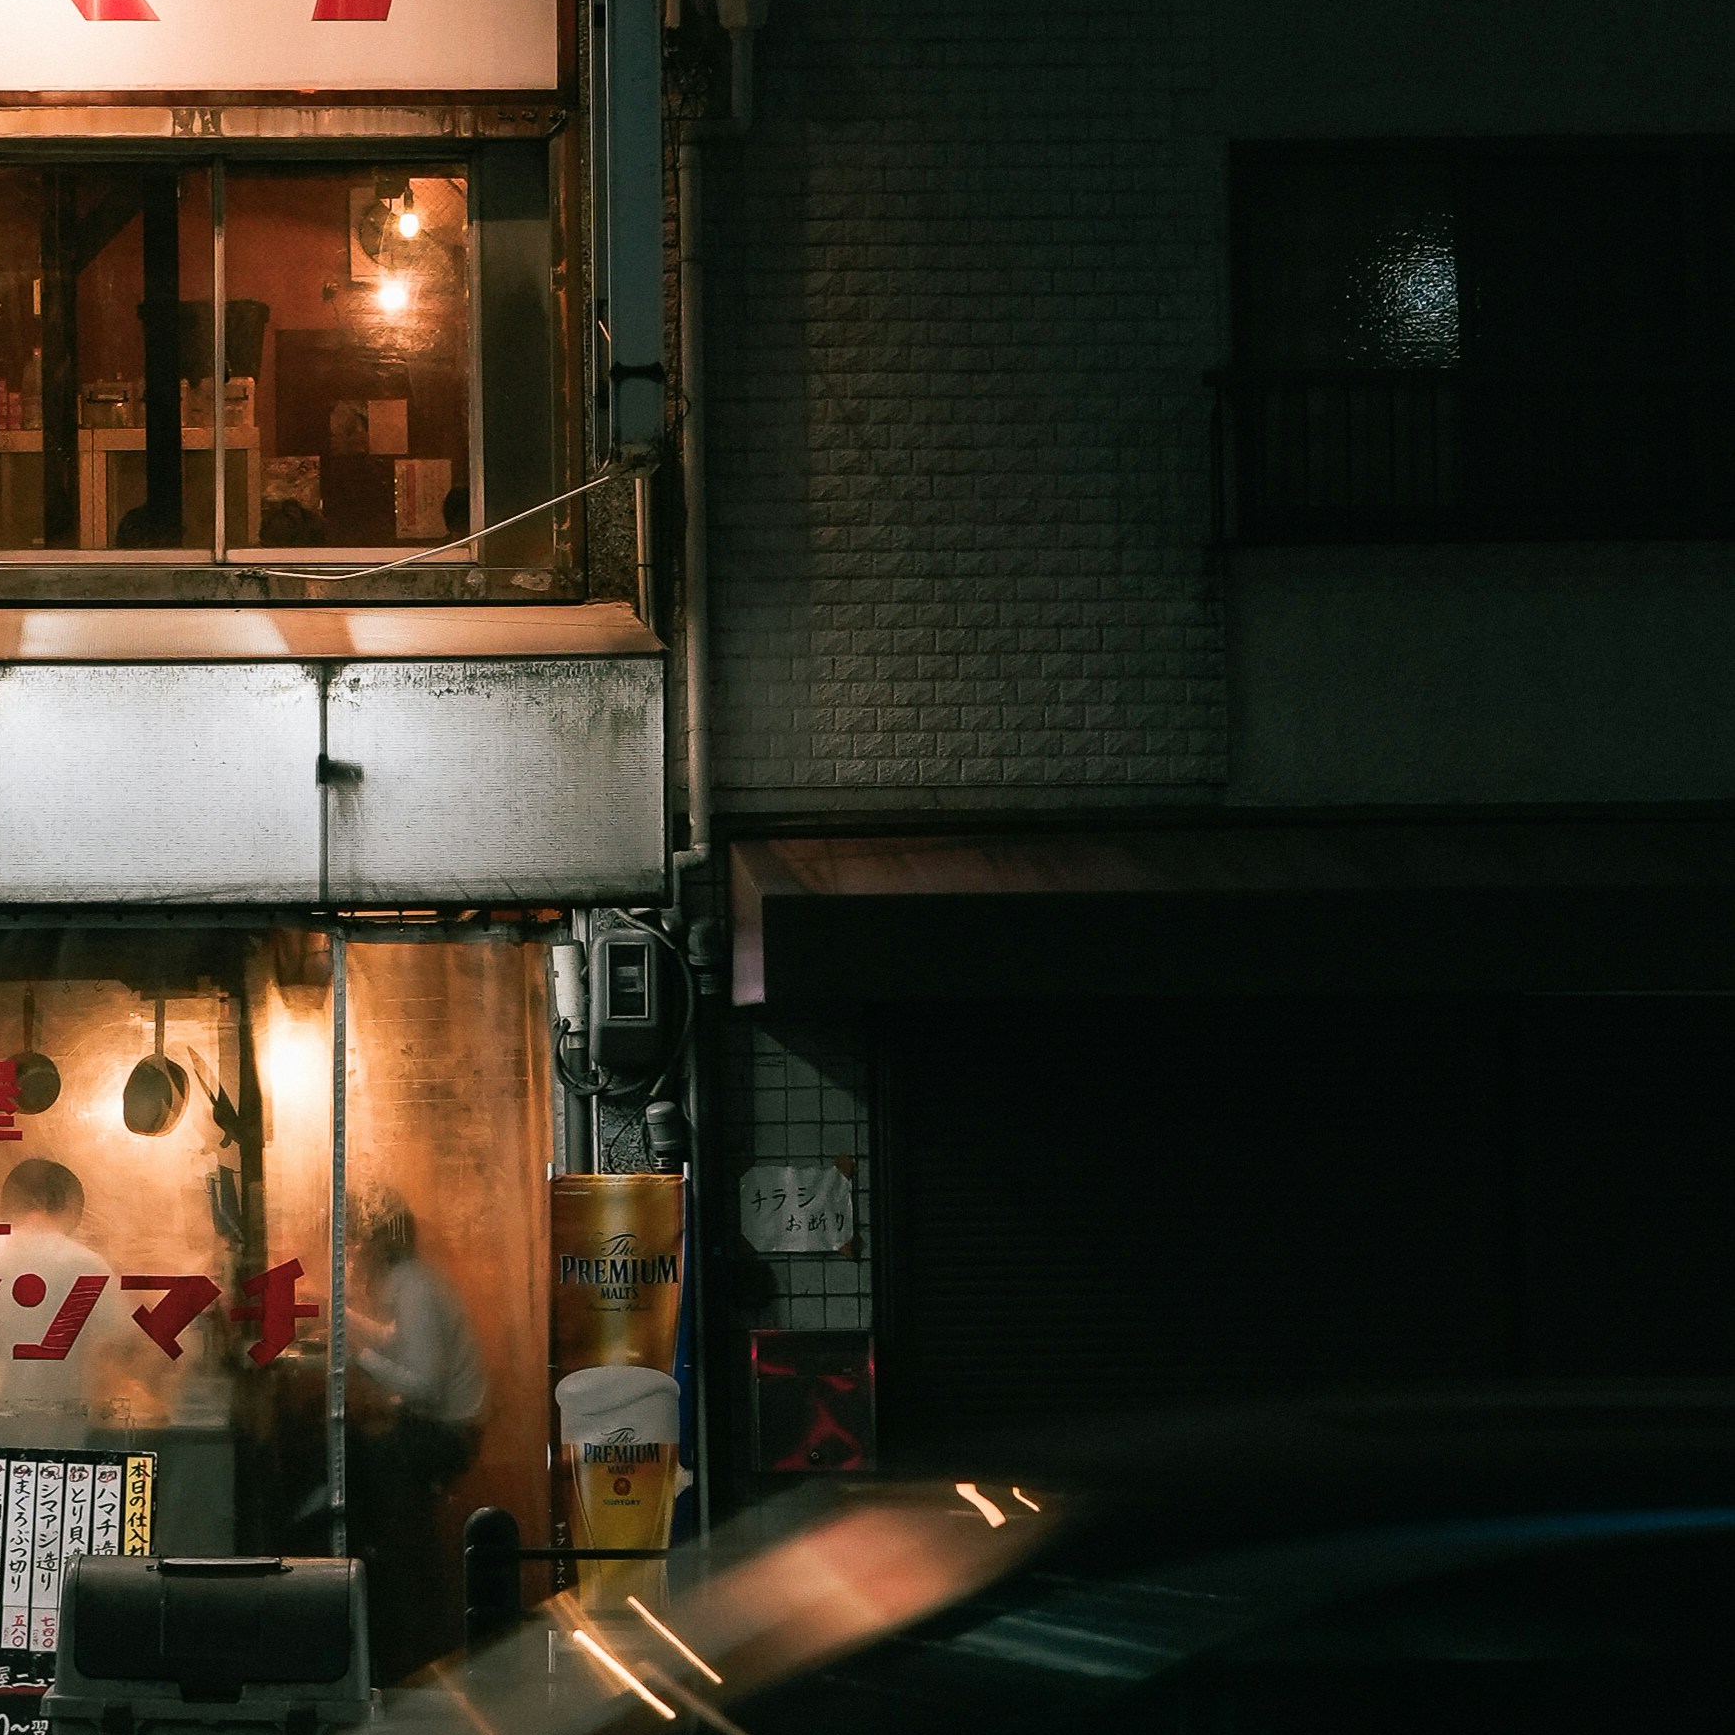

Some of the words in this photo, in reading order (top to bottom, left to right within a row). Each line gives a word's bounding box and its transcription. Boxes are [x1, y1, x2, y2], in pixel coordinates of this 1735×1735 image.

[751, 1187, 816, 1214] チラシ
[785, 1212, 845, 1232] お断り
[594, 1232, 639, 1257] The
[559, 1254, 680, 1284] PREMIUM
[601, 1427, 640, 1444] The
[583, 1442, 661, 1464] PREMIUM
[9, 1479, 31, 1593] まぐろぶつ切り
[36, 1484, 60, 1593] シマアジ造り
